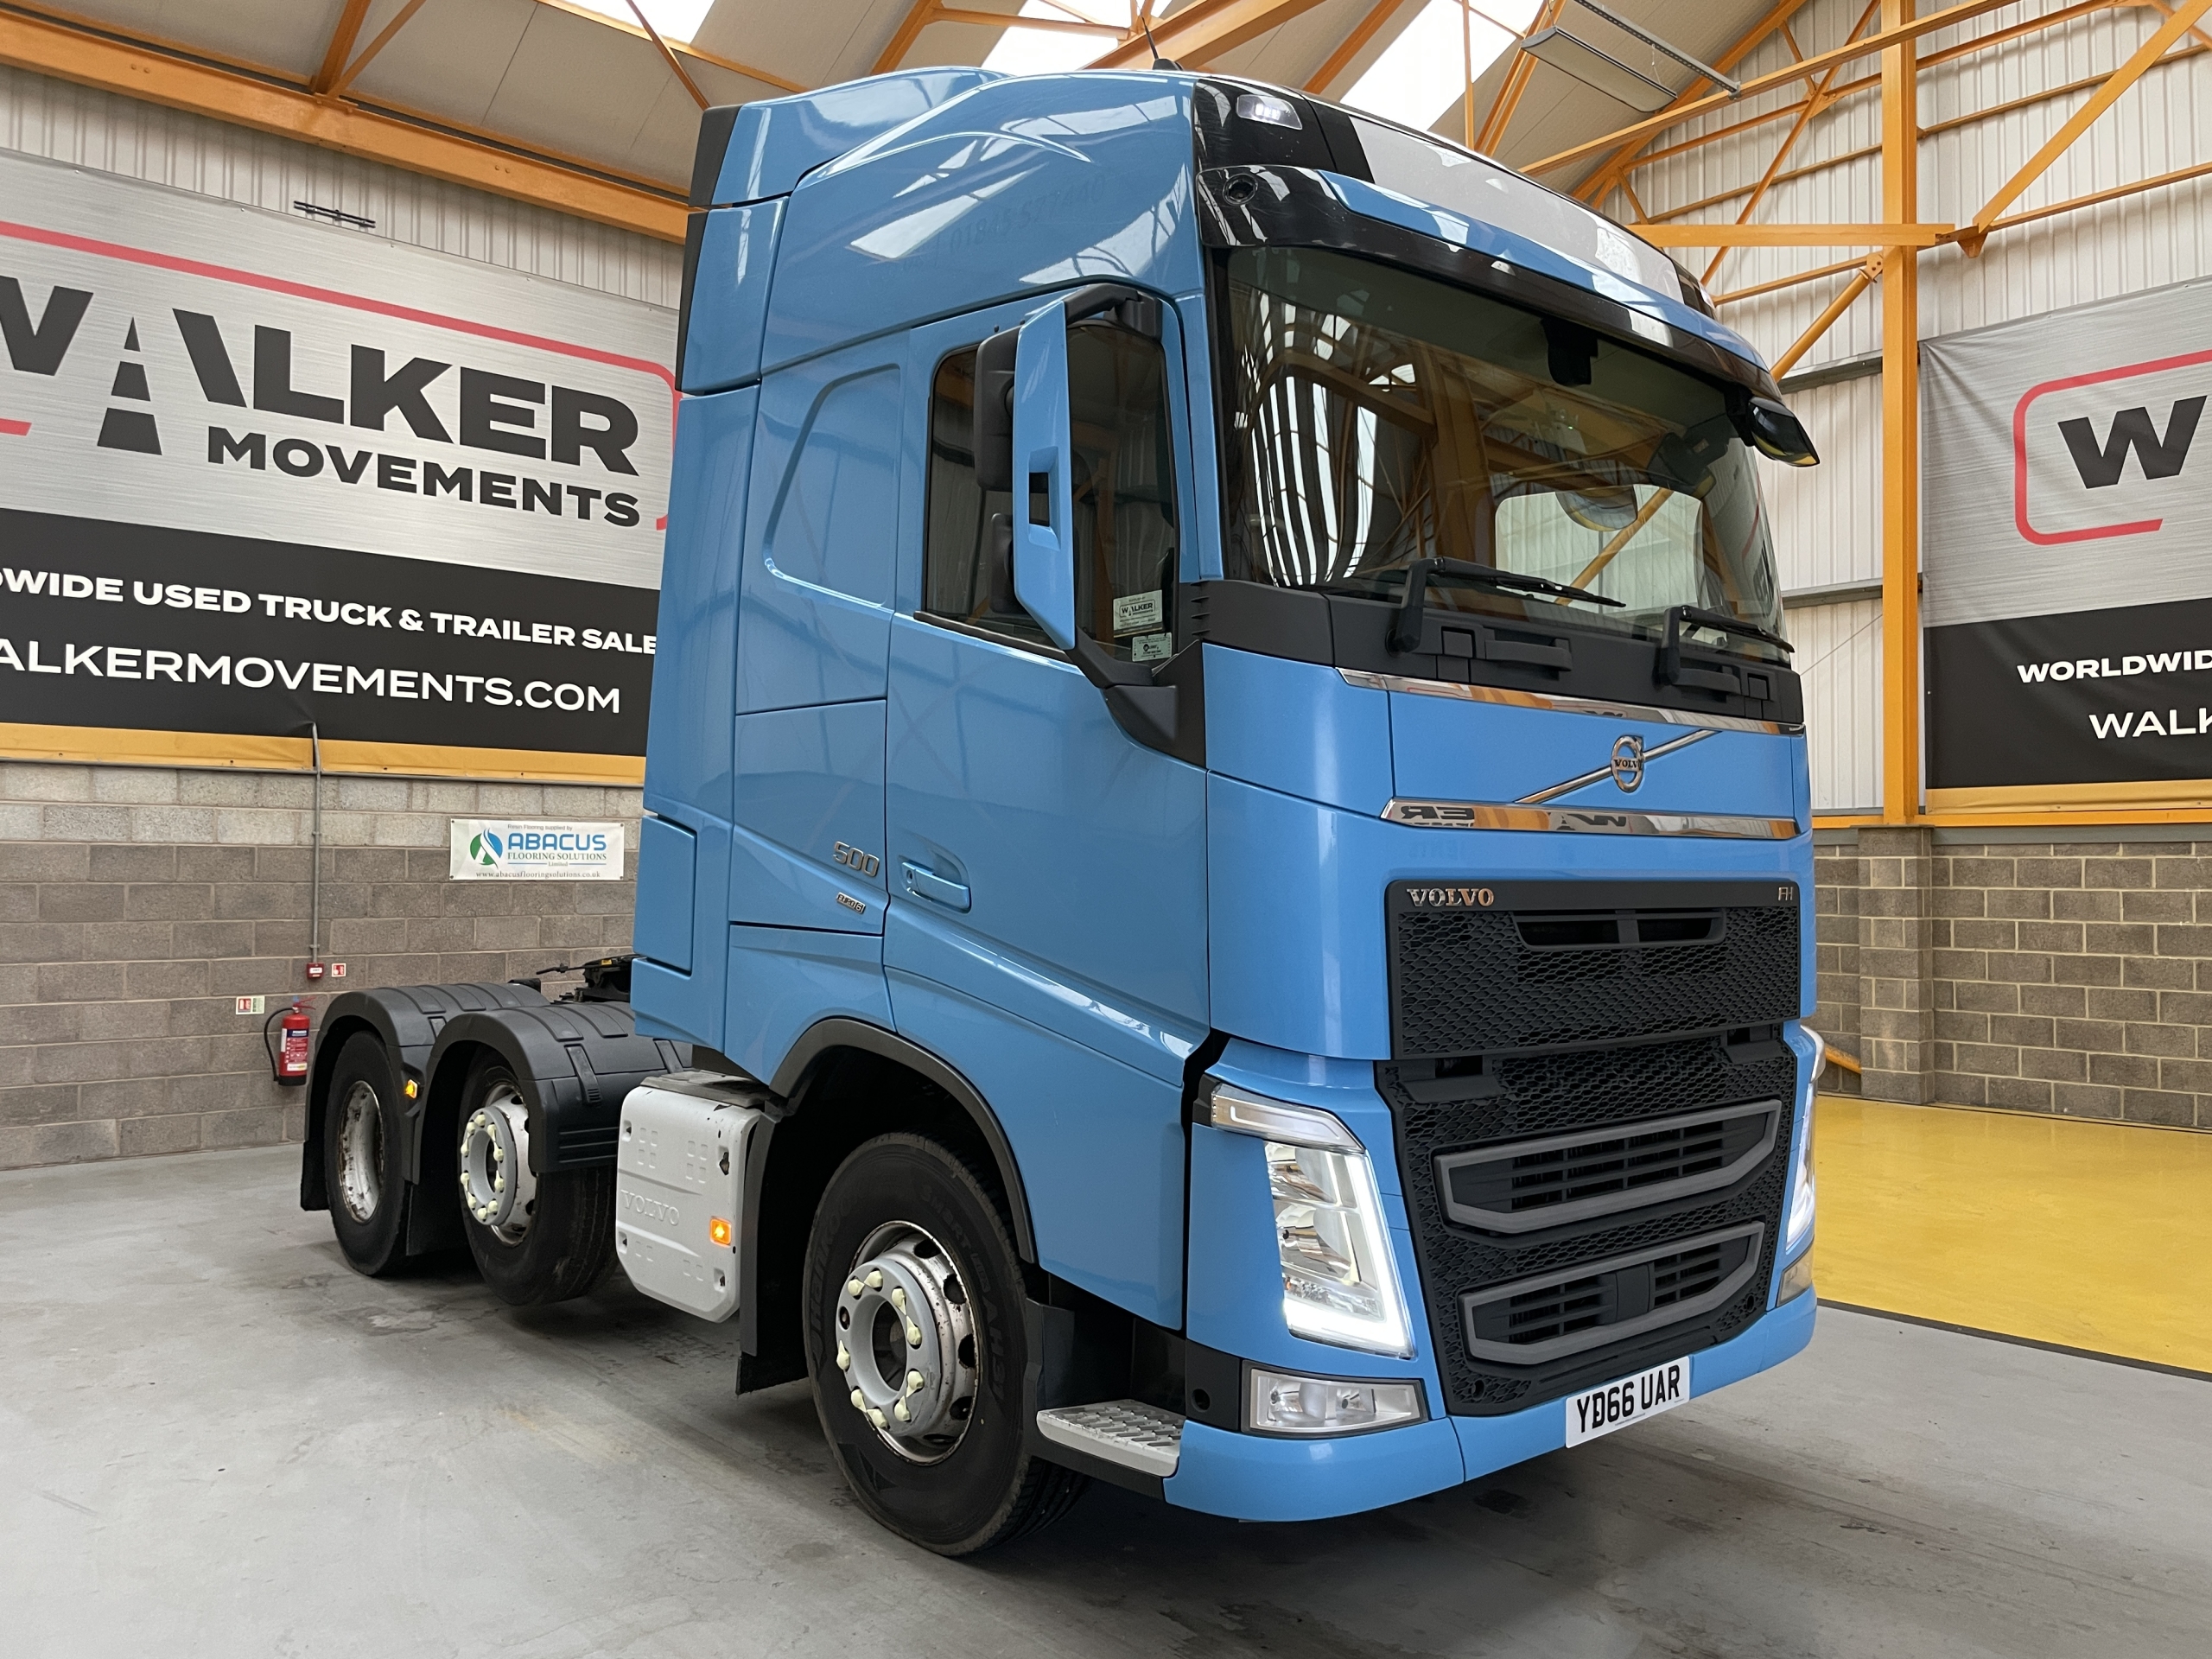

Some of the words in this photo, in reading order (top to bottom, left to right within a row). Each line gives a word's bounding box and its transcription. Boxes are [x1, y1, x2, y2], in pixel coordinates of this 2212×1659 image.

[2057, 395, 2208, 489] W
[208, 426, 640, 527] MOVEMENTS
[0, 568, 124, 602] WIDE
[133, 581, 251, 613] USED
[257, 593, 392, 632] TRUCK
[398, 608, 424, 632] &
[429, 612, 575, 647] TRAILER
[1122, 602, 1154, 616] WALKER
[507, 832, 607, 851] ABACUS
[507, 852, 556, 861] FLOORING
[832, 841, 880, 877] 500
[475, 870, 601, 880] www.abacusflooringsolutions.co.uk
[1406, 887, 1495, 907] VOLVO
[1777, 887, 1793, 901] FH
[620, 1189, 680, 1227] VOLVO
[1577, 1381, 1634, 1433] YD66
[1640, 1364, 1681, 1410] UAR
